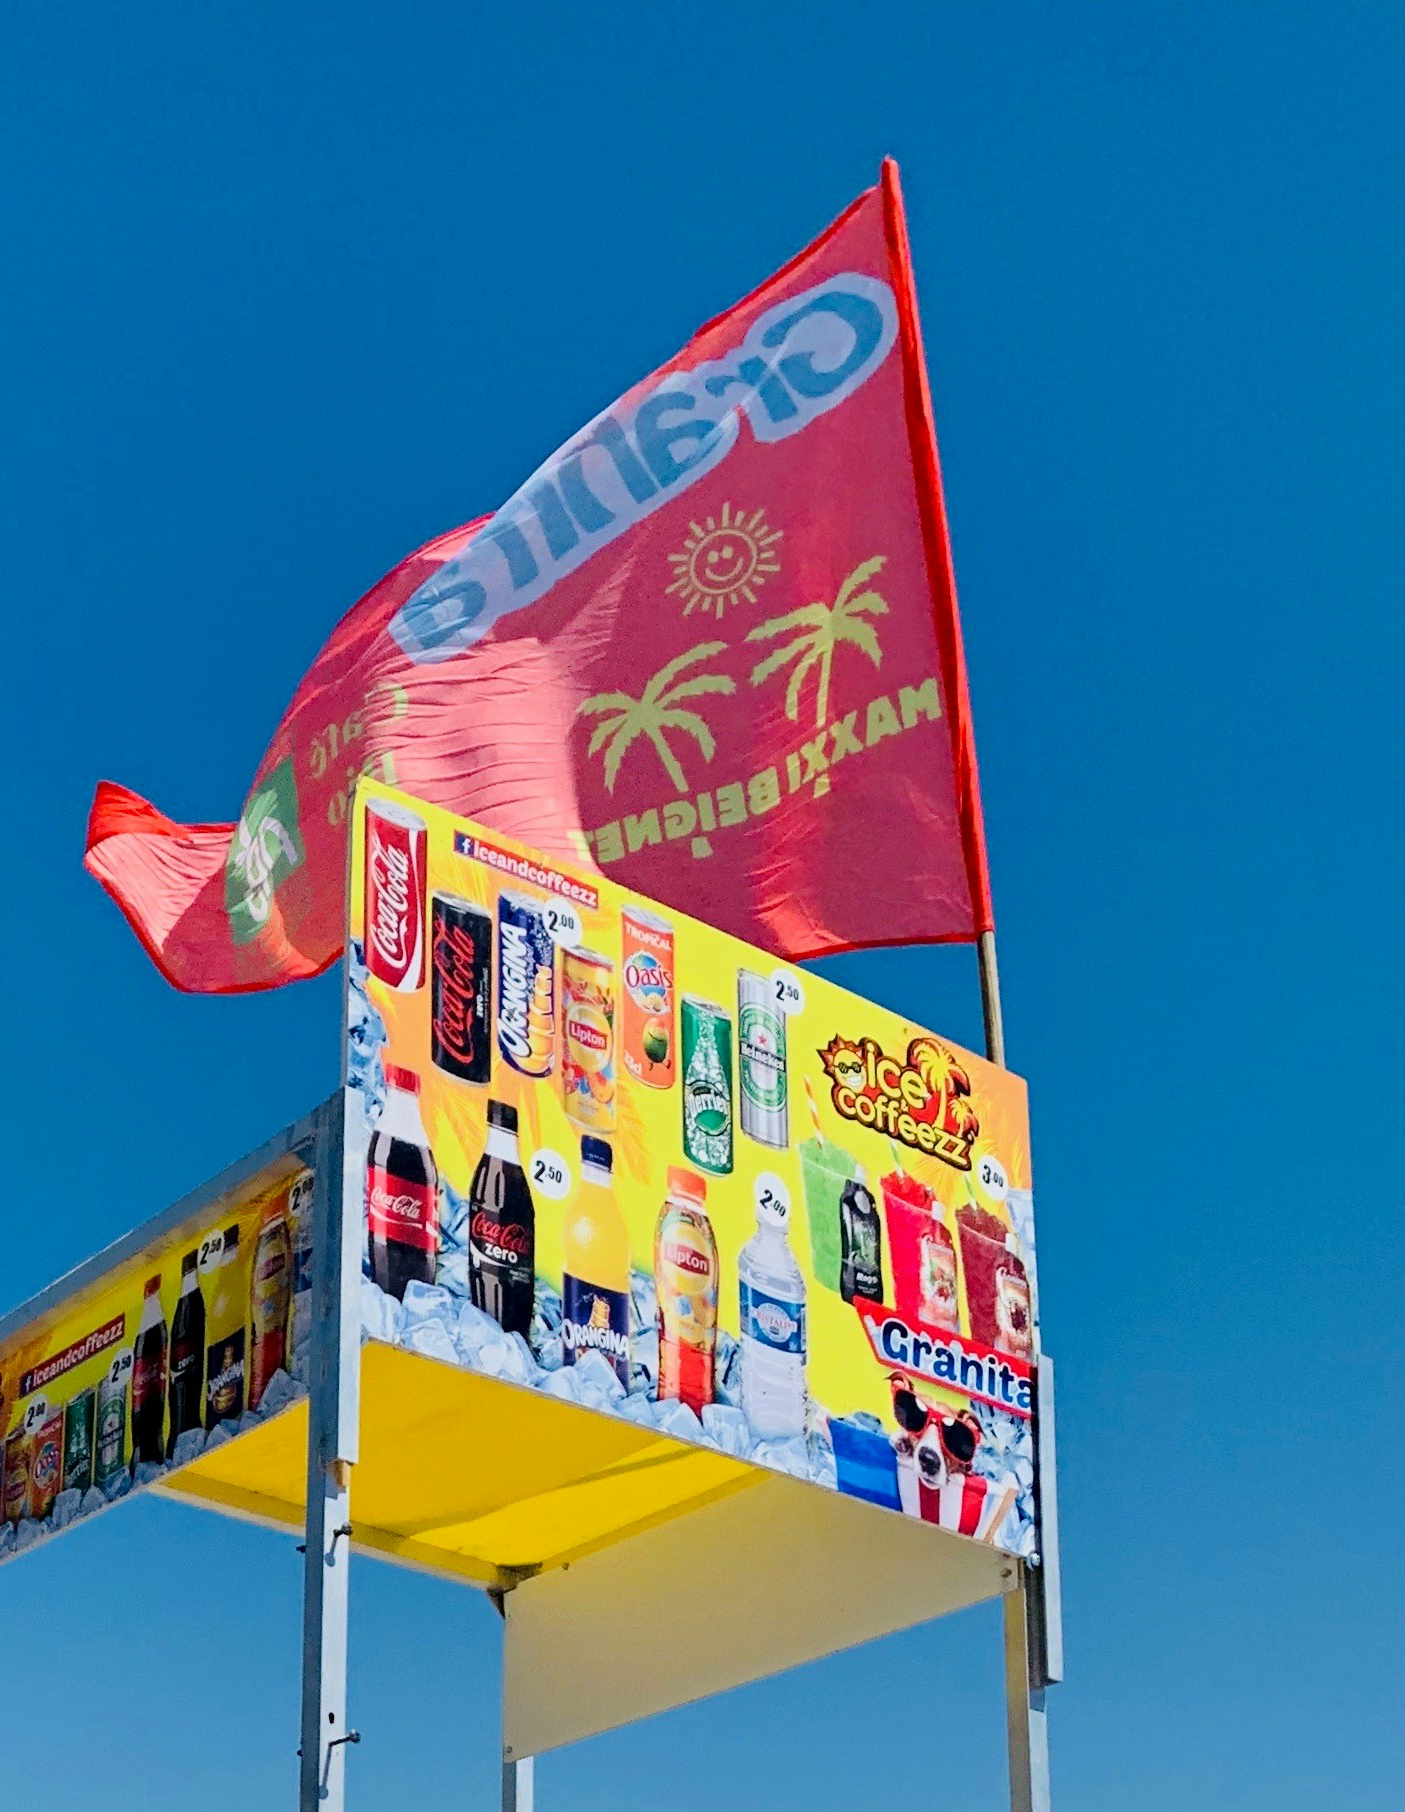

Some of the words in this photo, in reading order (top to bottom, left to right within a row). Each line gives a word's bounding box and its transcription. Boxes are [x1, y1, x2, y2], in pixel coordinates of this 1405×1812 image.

[626, 963, 674, 989] Oasis
[569, 1022, 606, 1049] Lipton
[484, 1241, 519, 1264] zero
[665, 1247, 709, 1273] Lipton
